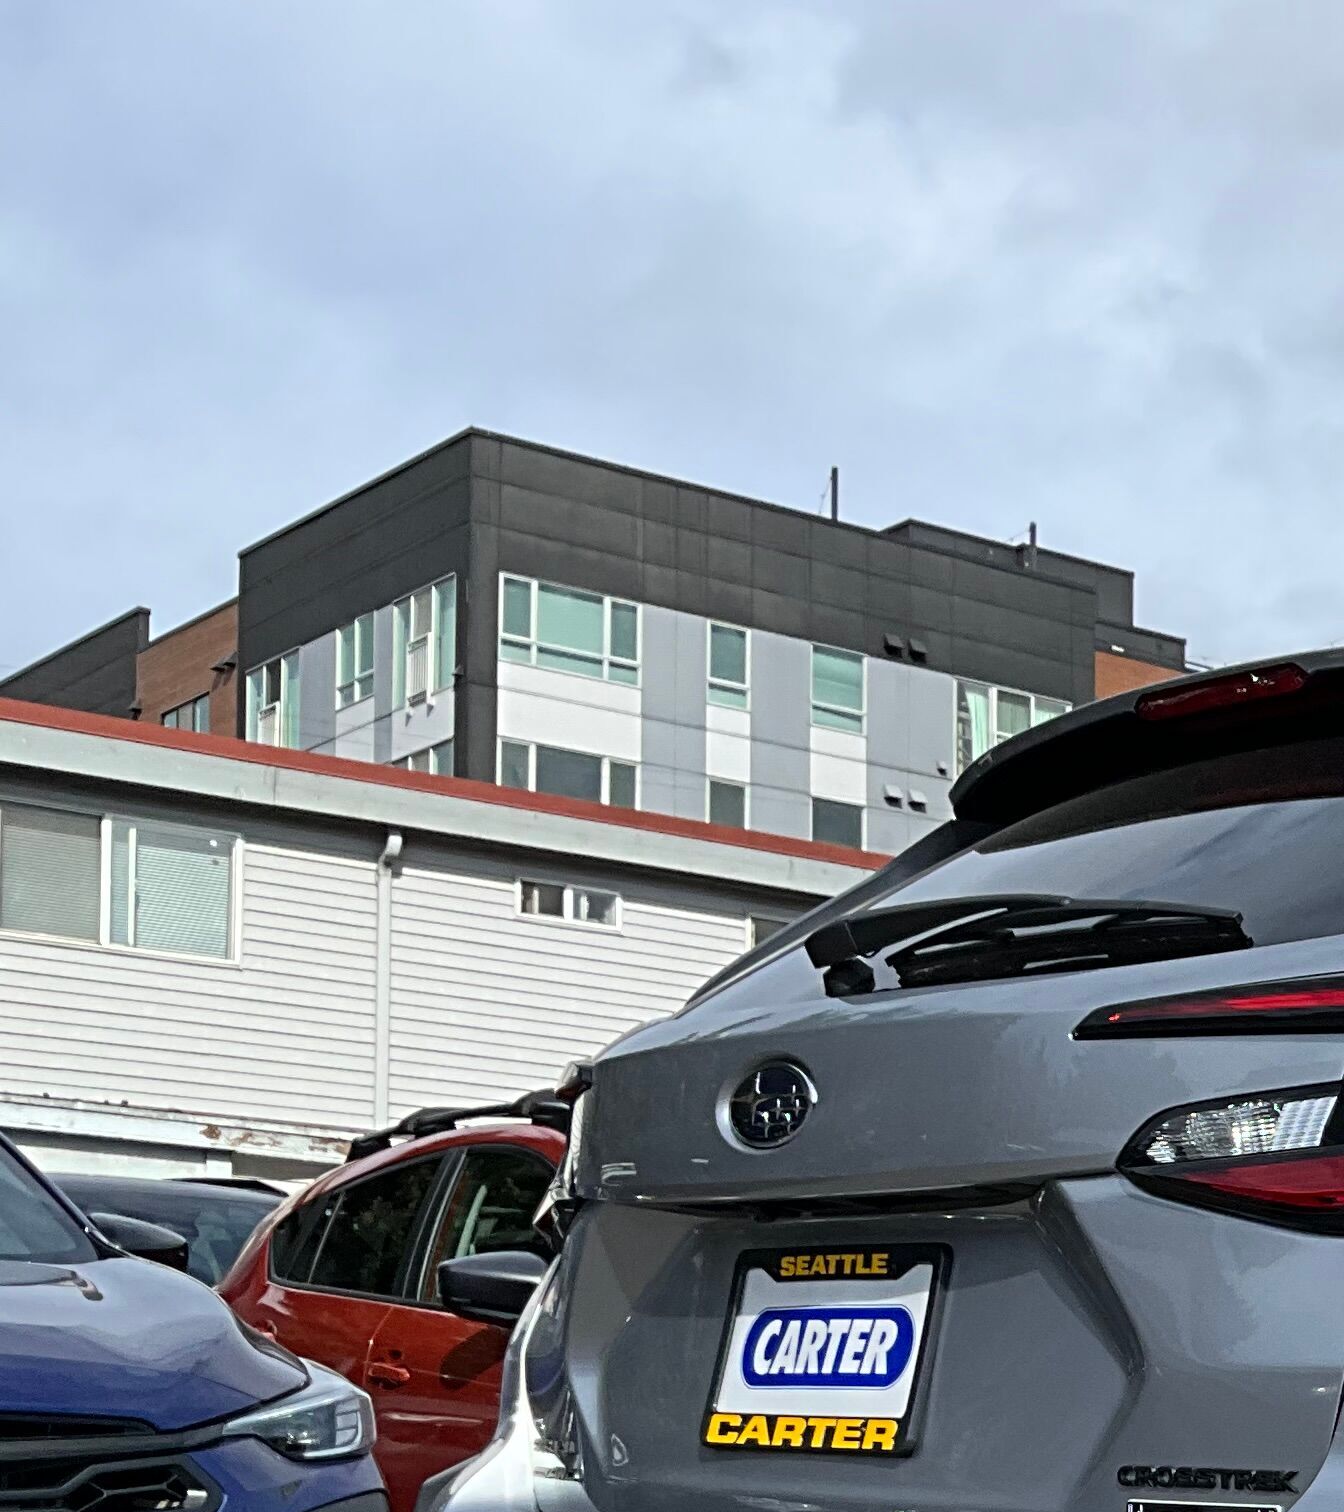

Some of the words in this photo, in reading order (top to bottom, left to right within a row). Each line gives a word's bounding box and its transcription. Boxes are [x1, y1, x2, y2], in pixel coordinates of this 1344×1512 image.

[779, 1253, 889, 1277] SEATTLE
[752, 1318, 899, 1376] CARTER
[705, 1413, 899, 1451] CARTER
[1116, 1465, 1300, 1493] CROSSTREK
